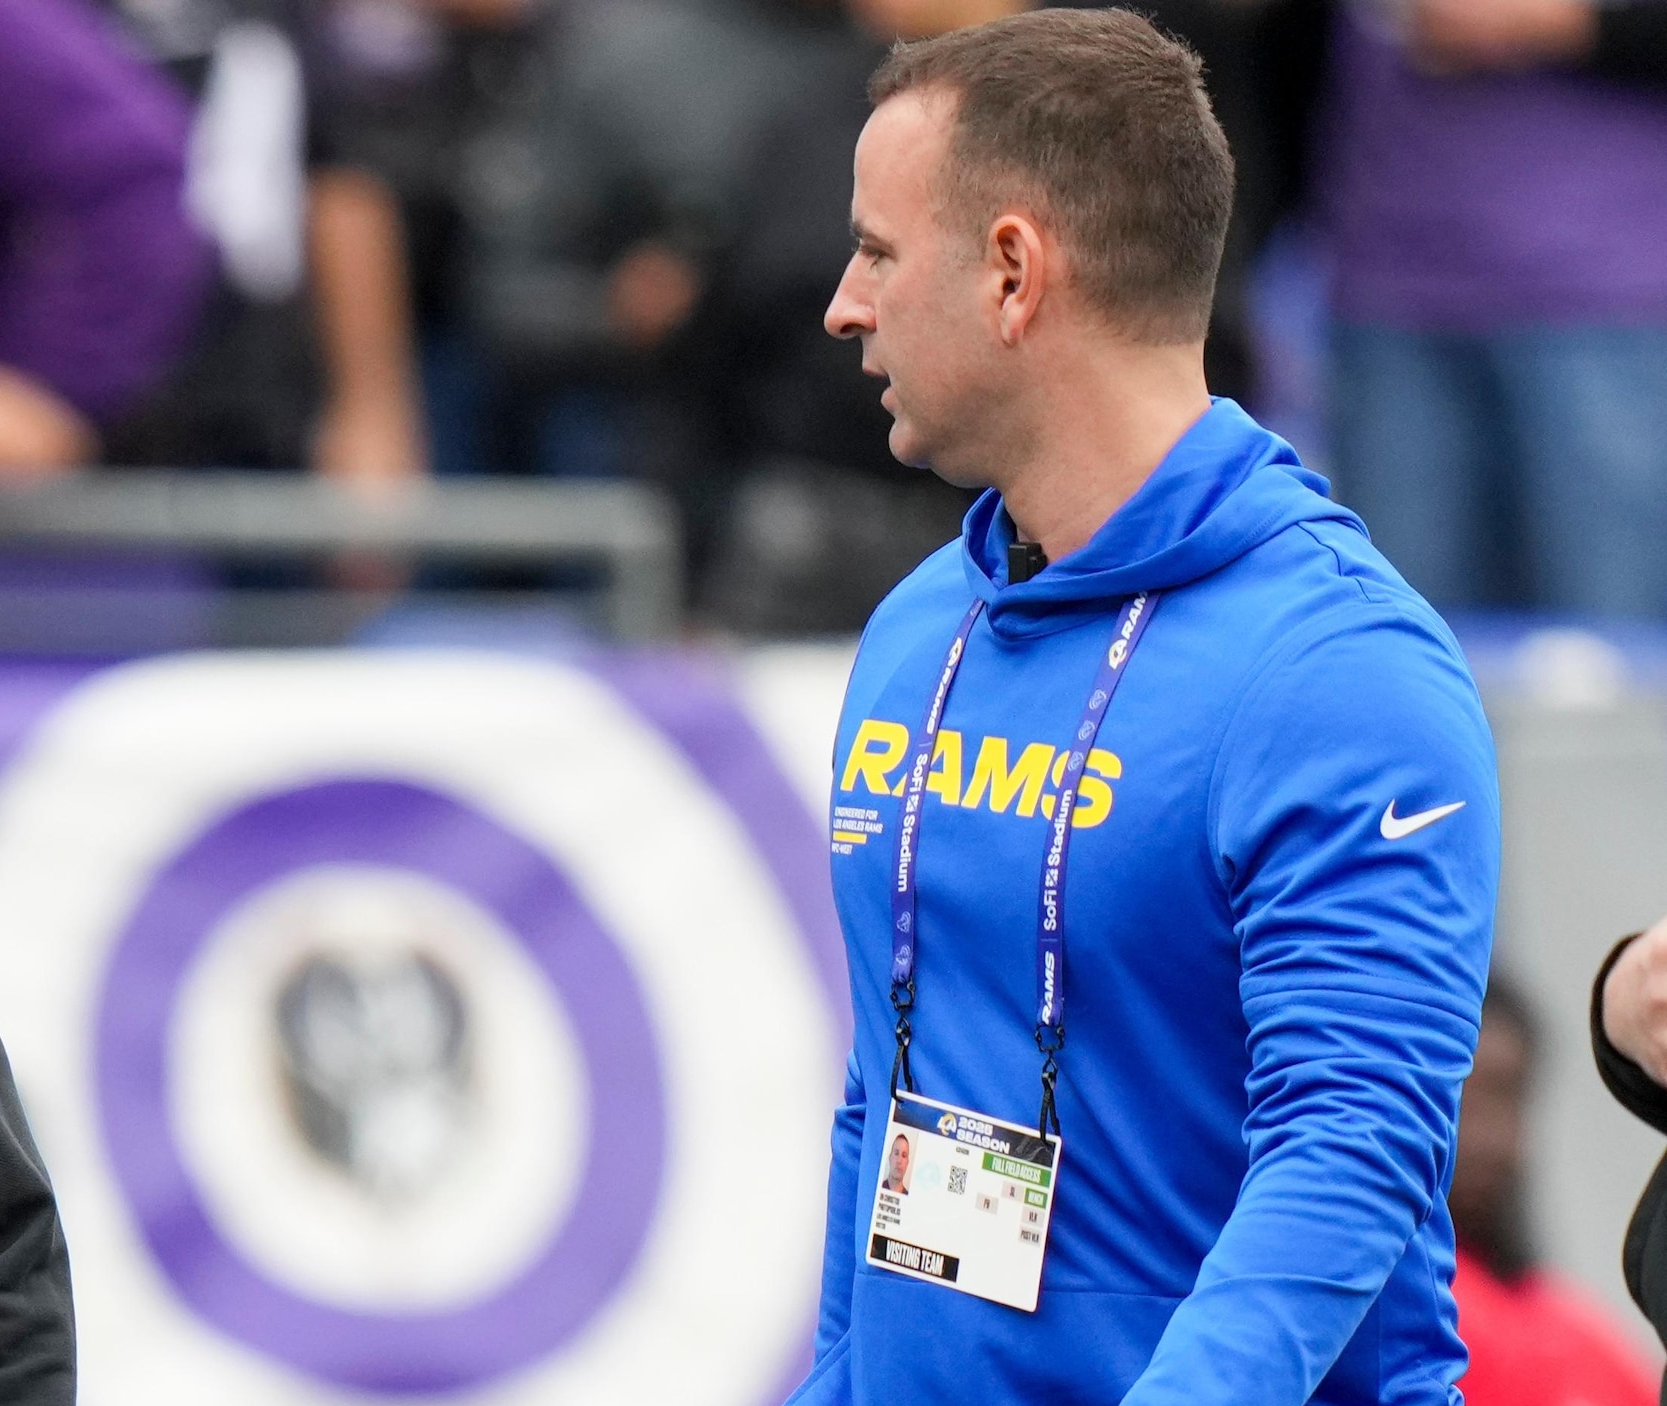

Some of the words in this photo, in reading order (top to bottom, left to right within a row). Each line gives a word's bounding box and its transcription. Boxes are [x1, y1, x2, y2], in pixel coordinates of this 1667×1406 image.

[1121, 591, 1148, 640] RAM
[840, 719, 1123, 829] RAMS
[1047, 789, 1073, 867] Stadium
[897, 814, 916, 892] Stadium
[1043, 890, 1057, 931] SoFi
[956, 1129, 1011, 1154] SEASON
[886, 1240, 921, 1269] VISITING
[920, 1249, 945, 1276] TEAM
